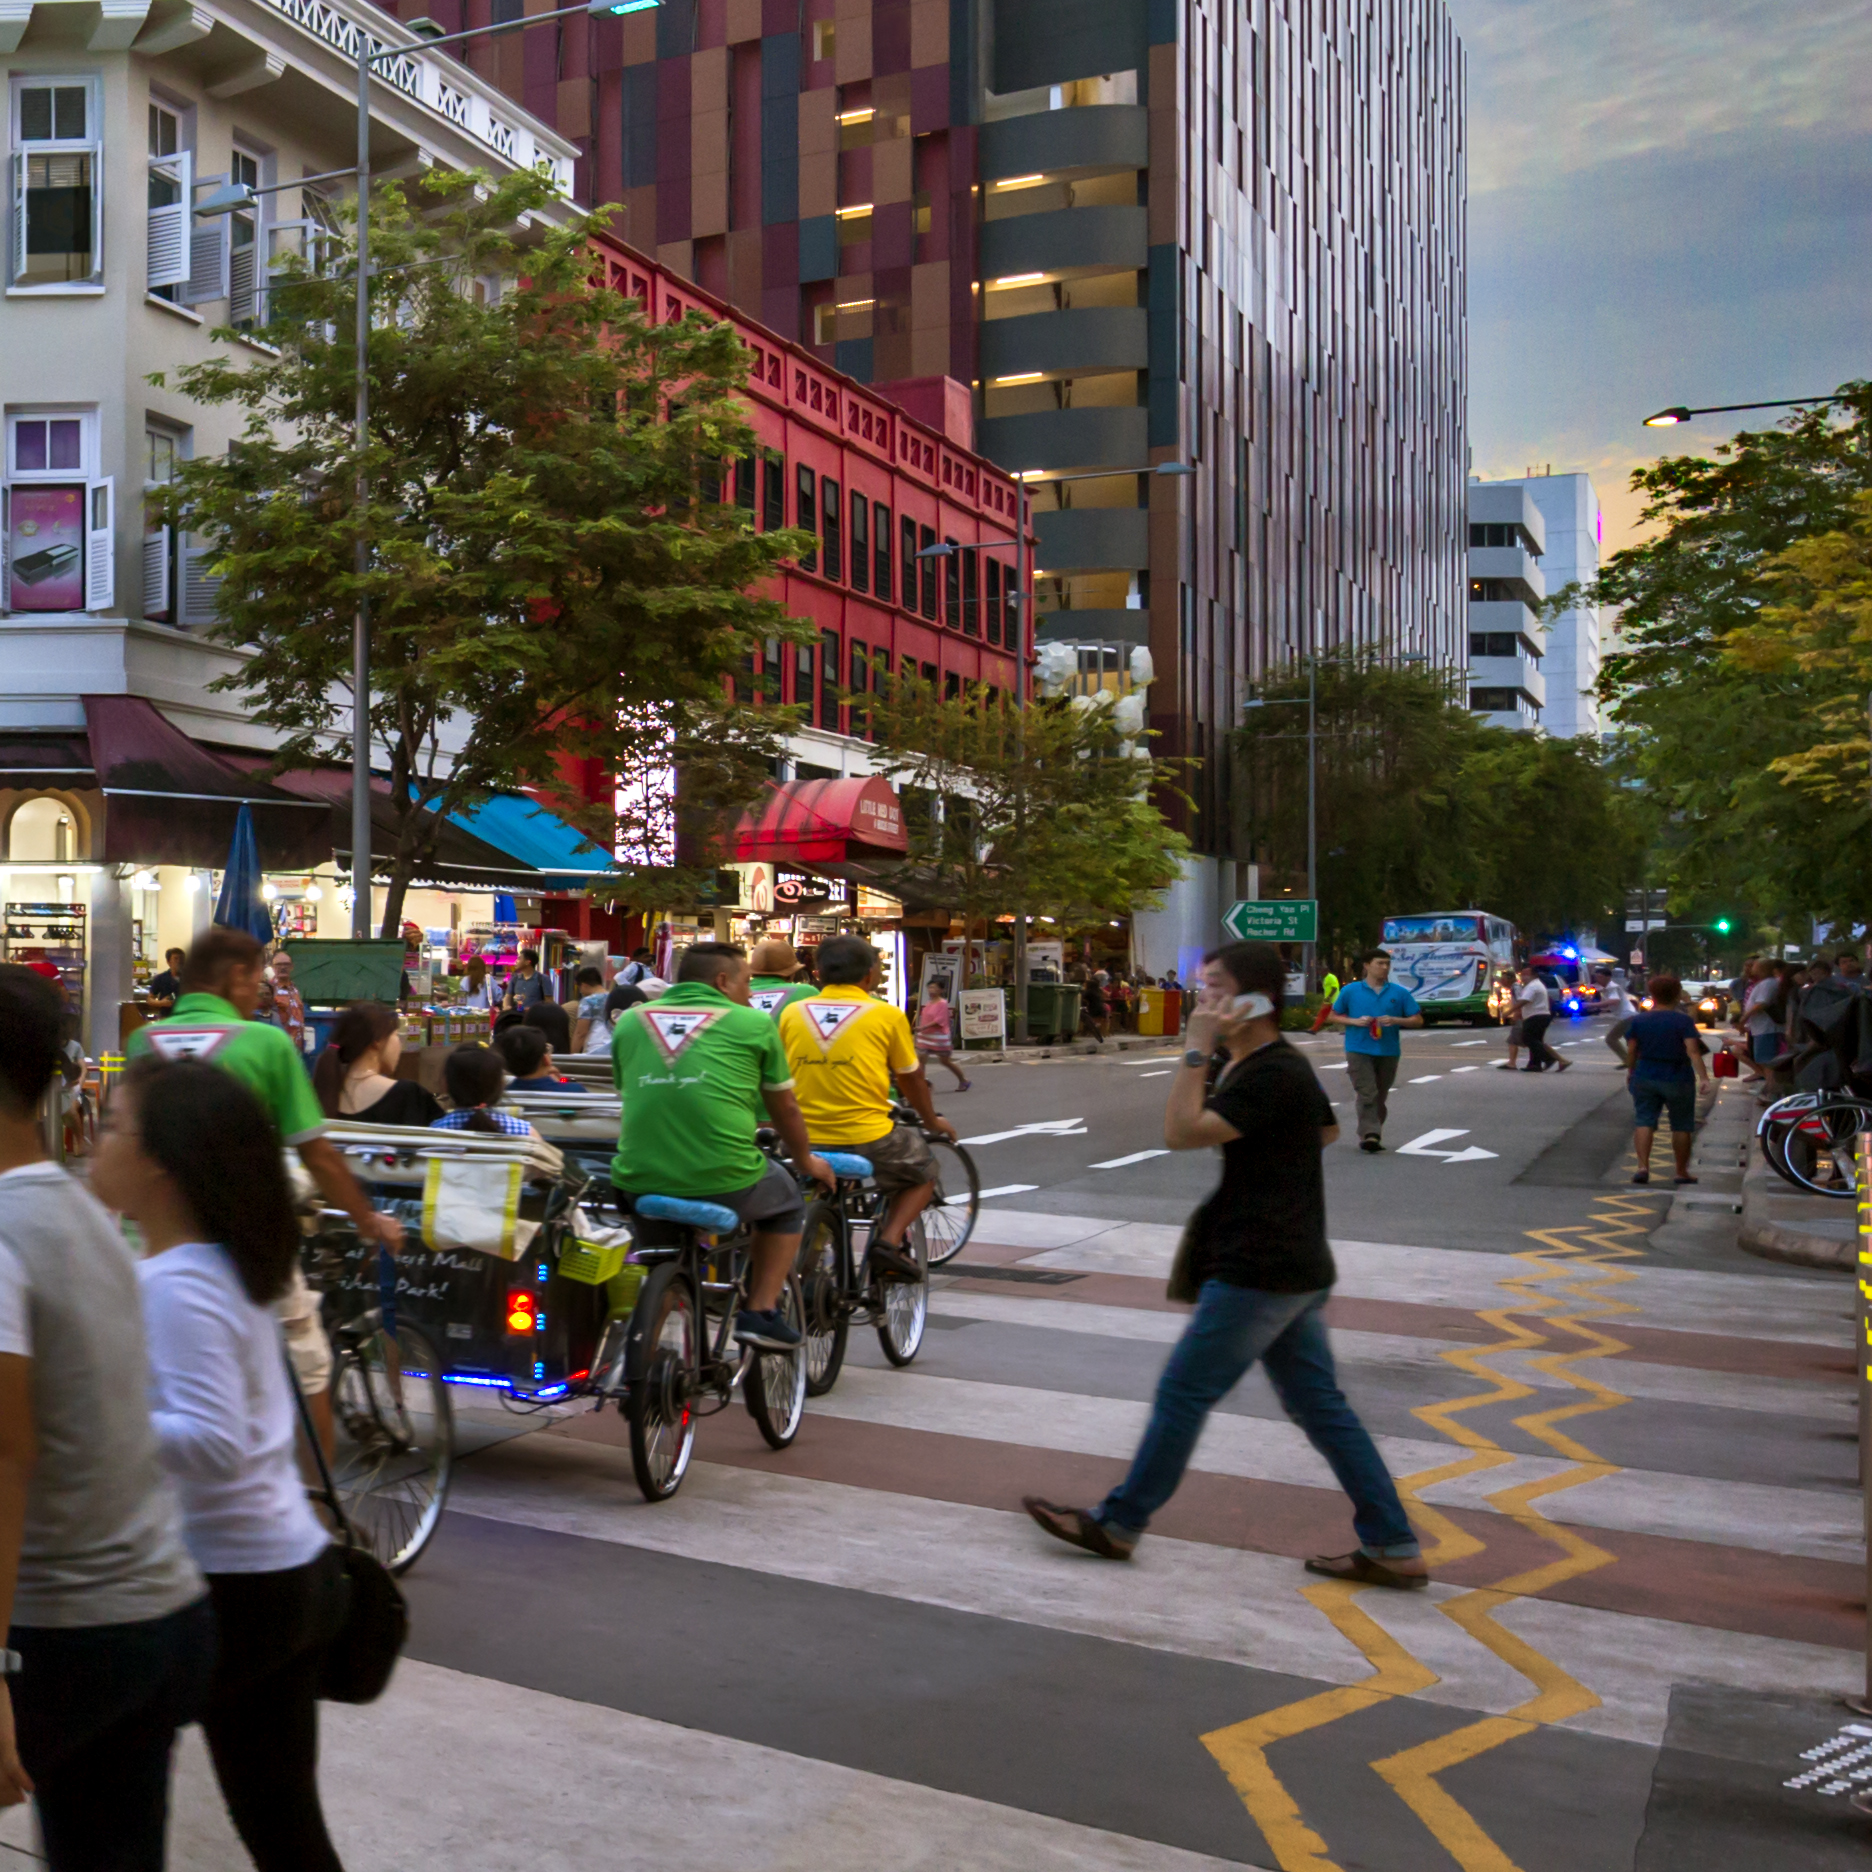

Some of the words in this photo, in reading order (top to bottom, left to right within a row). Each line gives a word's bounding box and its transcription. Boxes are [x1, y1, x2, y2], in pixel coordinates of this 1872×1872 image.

[1246, 917, 1282, 925] Victoria
[795, 1056, 828, 1068] Thank
[638, 1070, 675, 1088] Thank
[432, 1253, 484, 1272] Mall
[394, 1277, 450, 1300] Park!
